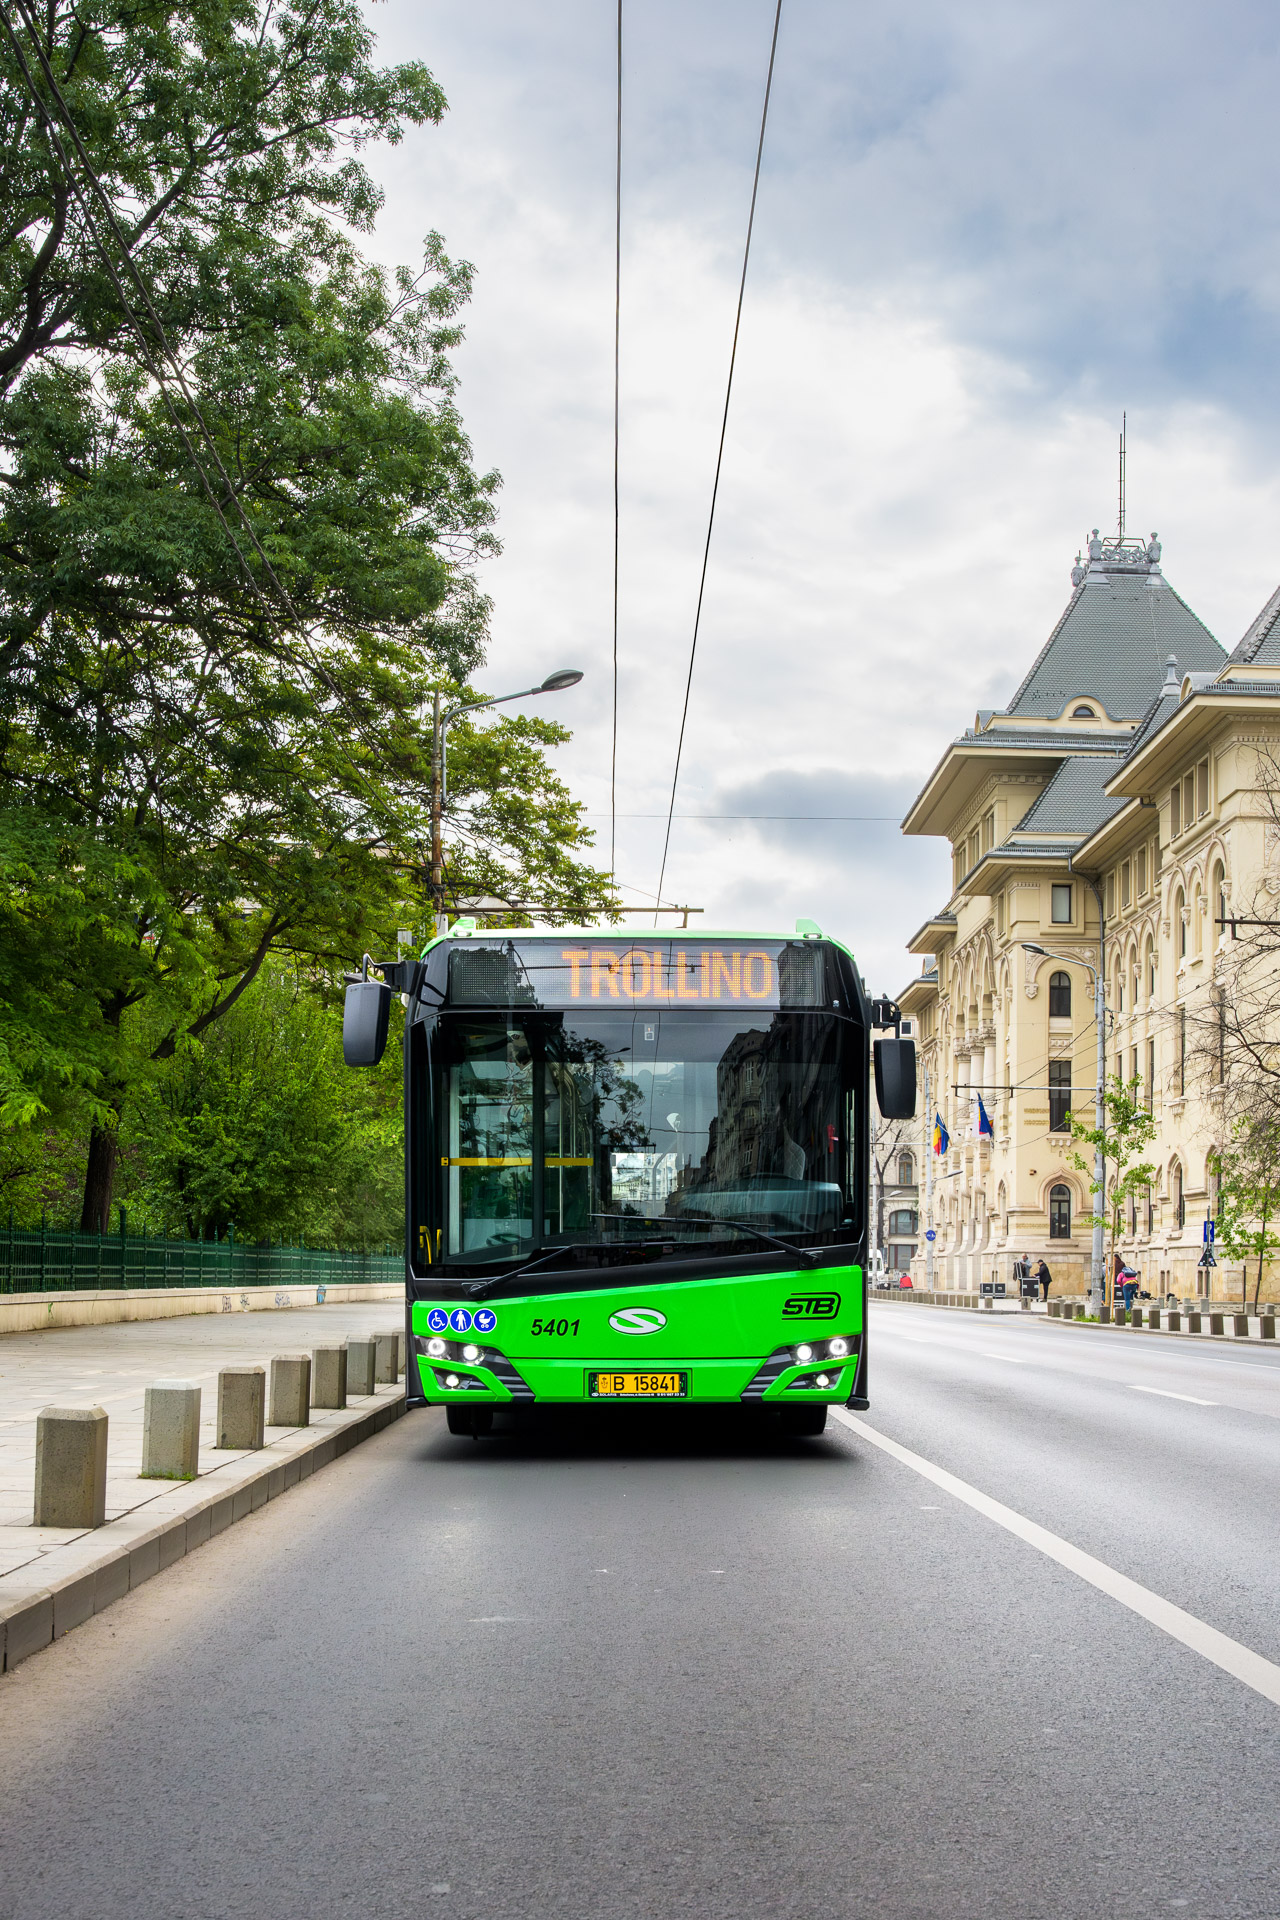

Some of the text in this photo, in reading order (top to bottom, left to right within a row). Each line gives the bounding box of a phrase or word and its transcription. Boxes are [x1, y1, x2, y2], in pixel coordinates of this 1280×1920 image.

[562, 951, 773, 998] TROLLINO
[781, 1297, 836, 1315] STB
[530, 1318, 580, 1337] 5401
[613, 1375, 675, 1391] B 15841
